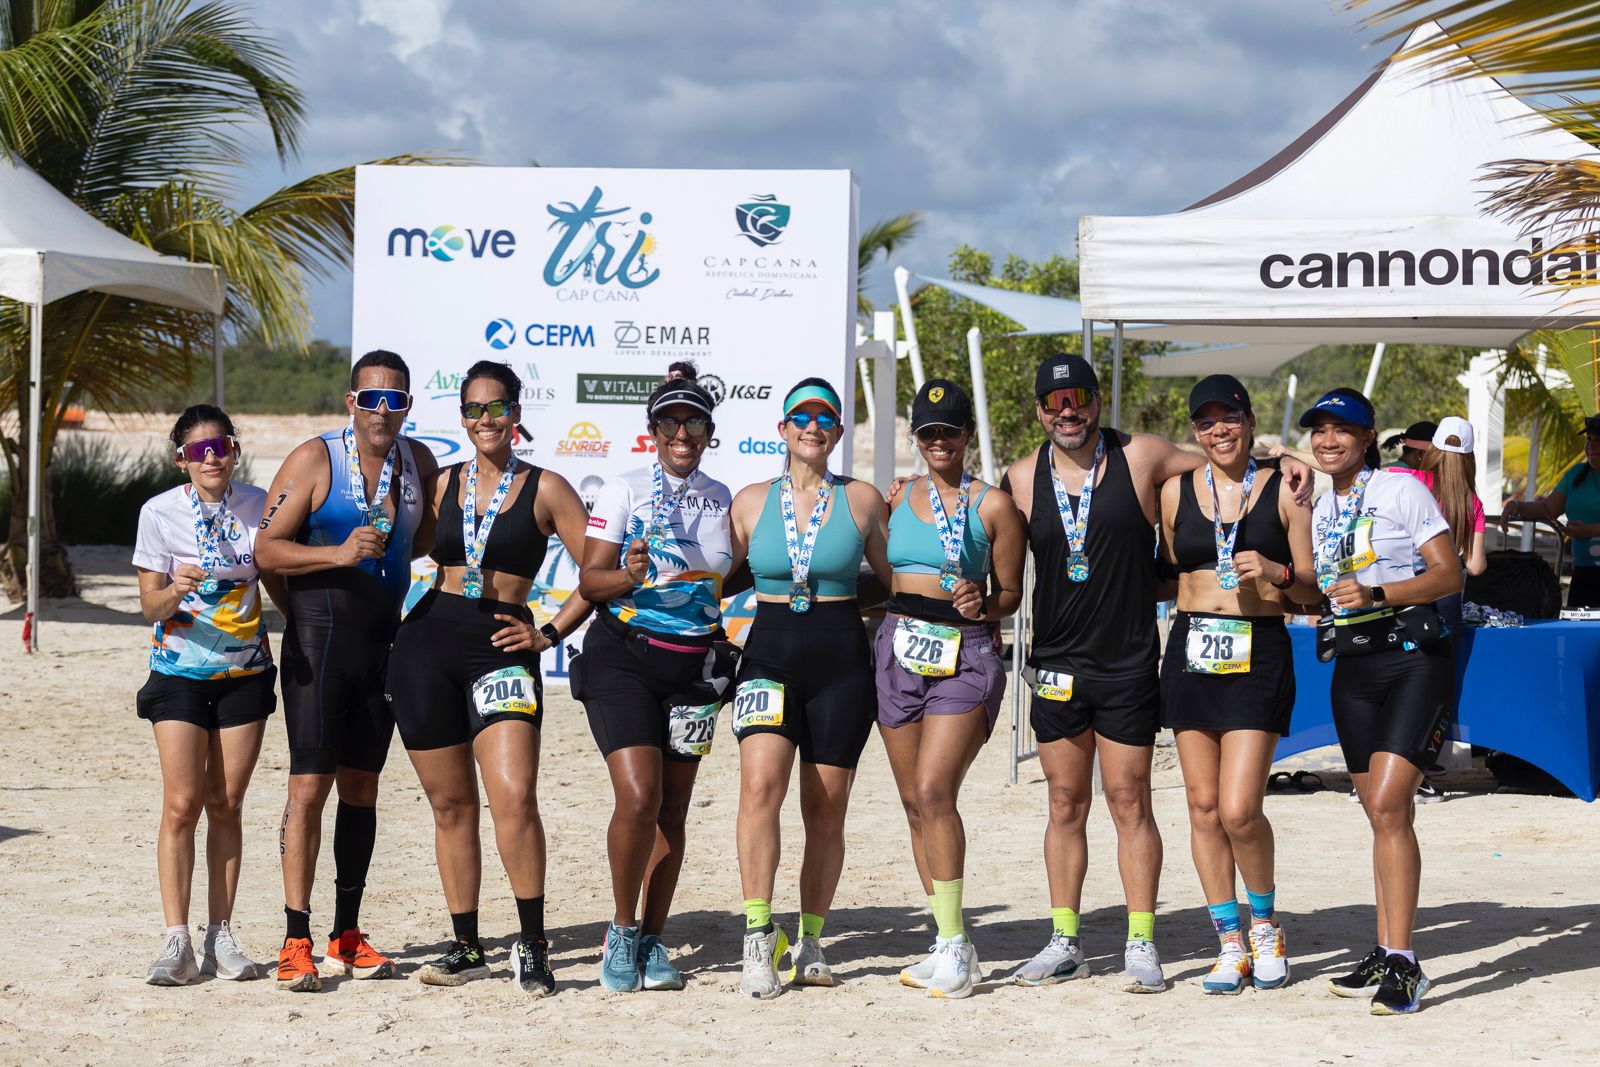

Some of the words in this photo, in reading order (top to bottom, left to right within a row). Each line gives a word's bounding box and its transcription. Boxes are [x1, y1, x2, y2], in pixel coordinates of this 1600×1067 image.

[758, 271, 818, 279] DOMINICANA
[556, 288, 589, 302] CAP
[593, 289, 640, 303] CANA
[525, 323, 595, 347] CEPM
[729, 385, 772, 399] K&G
[557, 440, 611, 451] SUNRIDE
[904, 634, 944, 665] 226
[1200, 634, 1234, 661] 213
[927, 666, 947, 676] CEPM
[1222, 663, 1242, 671] CEPM
[483, 678, 525, 705] 204
[737, 690, 769, 721] 220
[682, 716, 715, 744] 223
